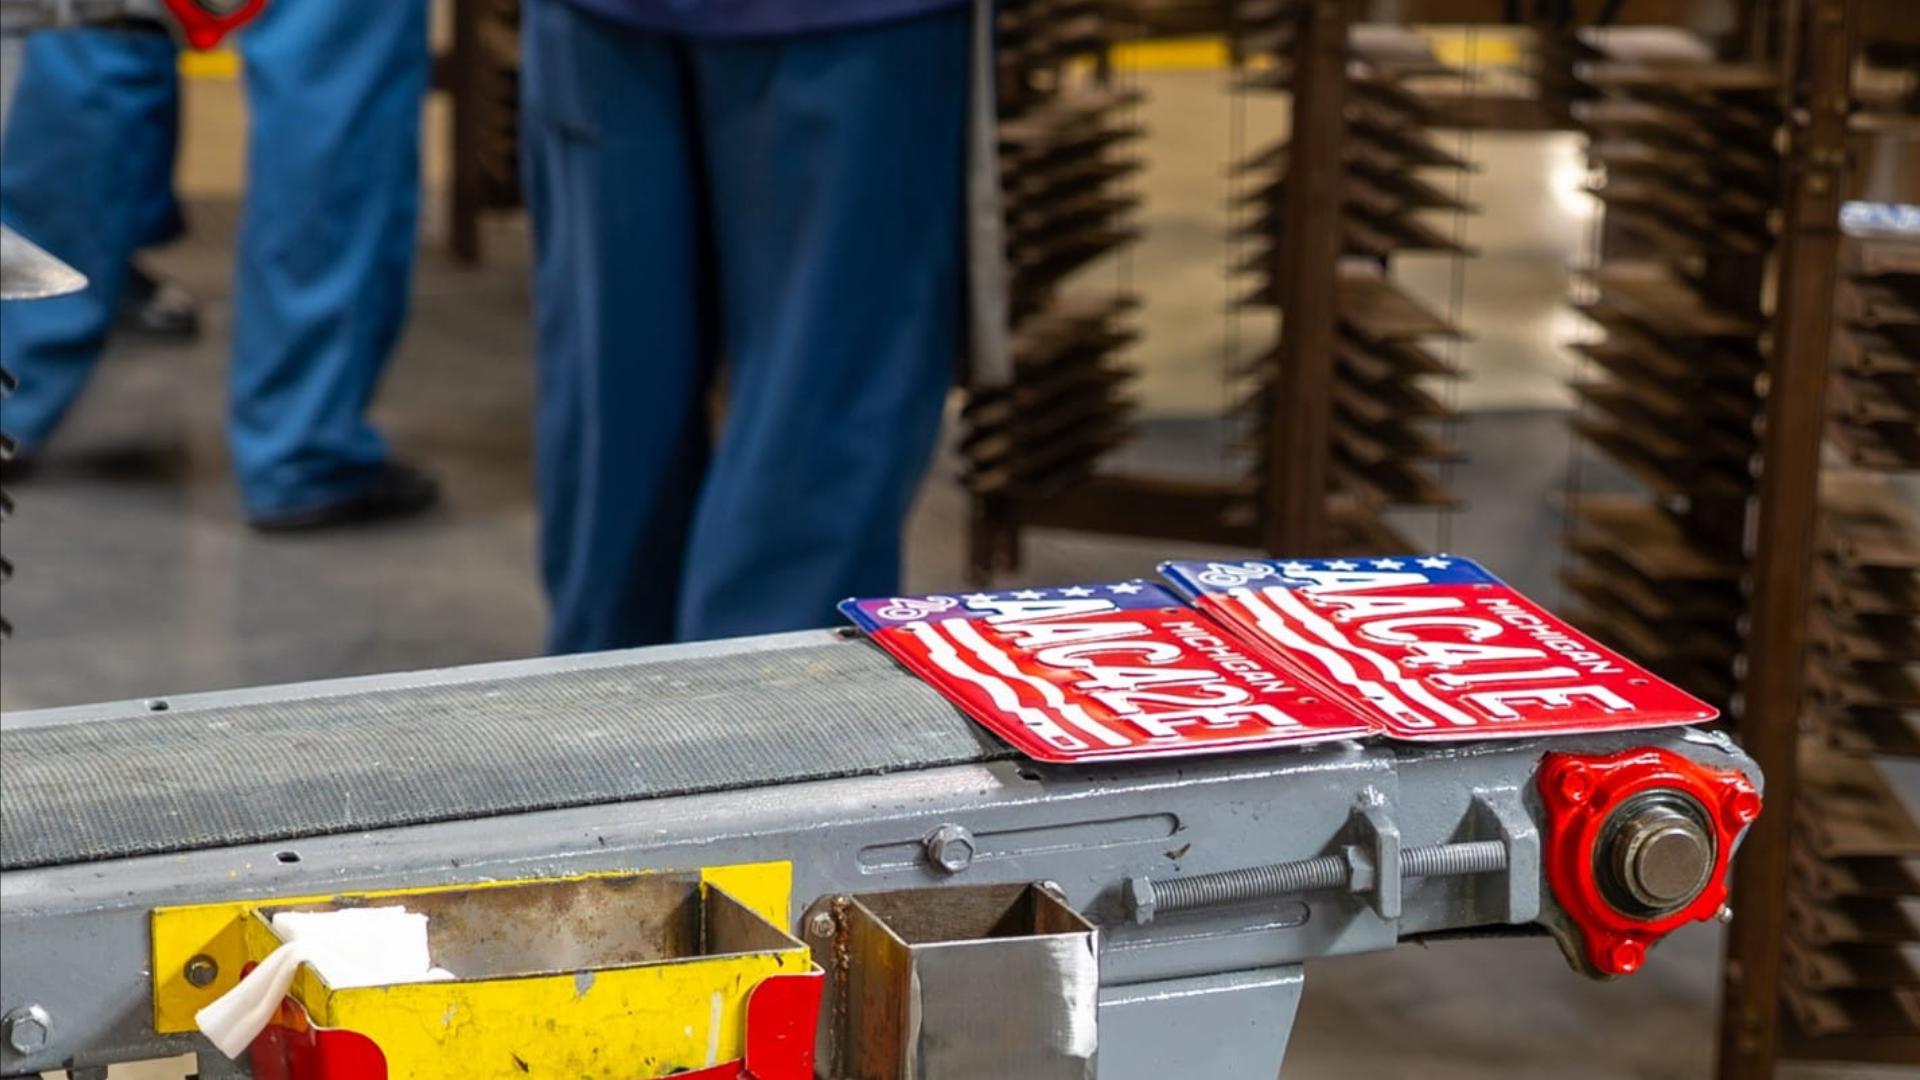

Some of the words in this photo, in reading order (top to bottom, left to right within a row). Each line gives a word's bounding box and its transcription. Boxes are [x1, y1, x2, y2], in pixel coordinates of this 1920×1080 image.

[967, 599, 1301, 738] AAC42E
[1161, 620, 1297, 694] MICHIGAN
[1284, 569, 1635, 721] AAC41E
[1477, 598, 1624, 675] MICHIGAN
